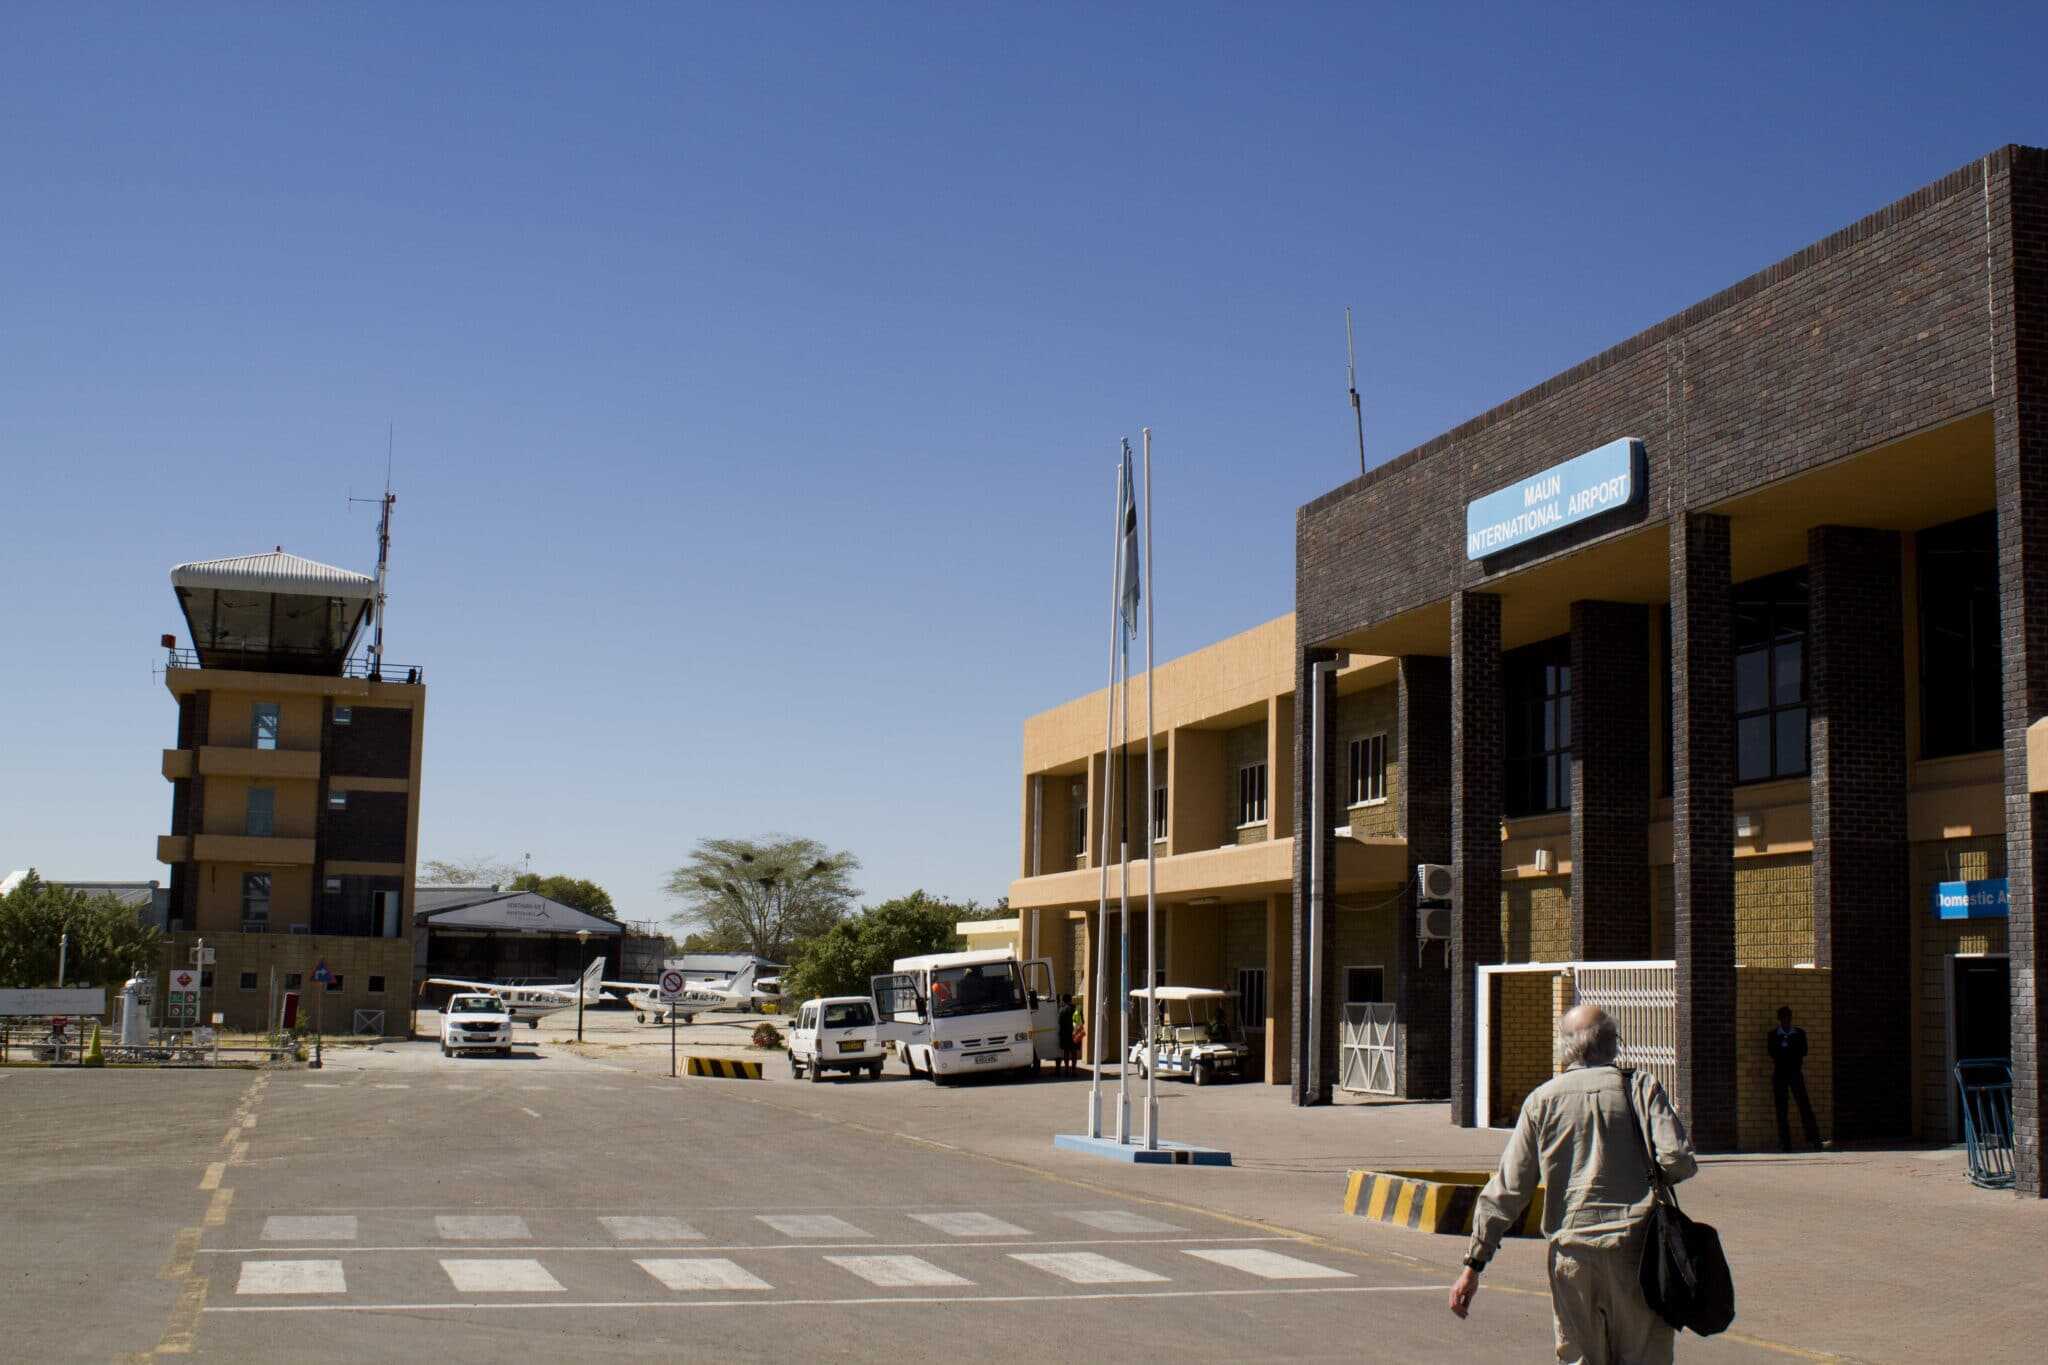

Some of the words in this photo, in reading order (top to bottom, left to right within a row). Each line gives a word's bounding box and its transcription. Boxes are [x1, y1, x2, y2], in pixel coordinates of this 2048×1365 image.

[1469, 500, 1562, 552] INTERNATIONAL
[1567, 474, 1627, 516] AIRPORT
[1524, 474, 1561, 508] MAUN
